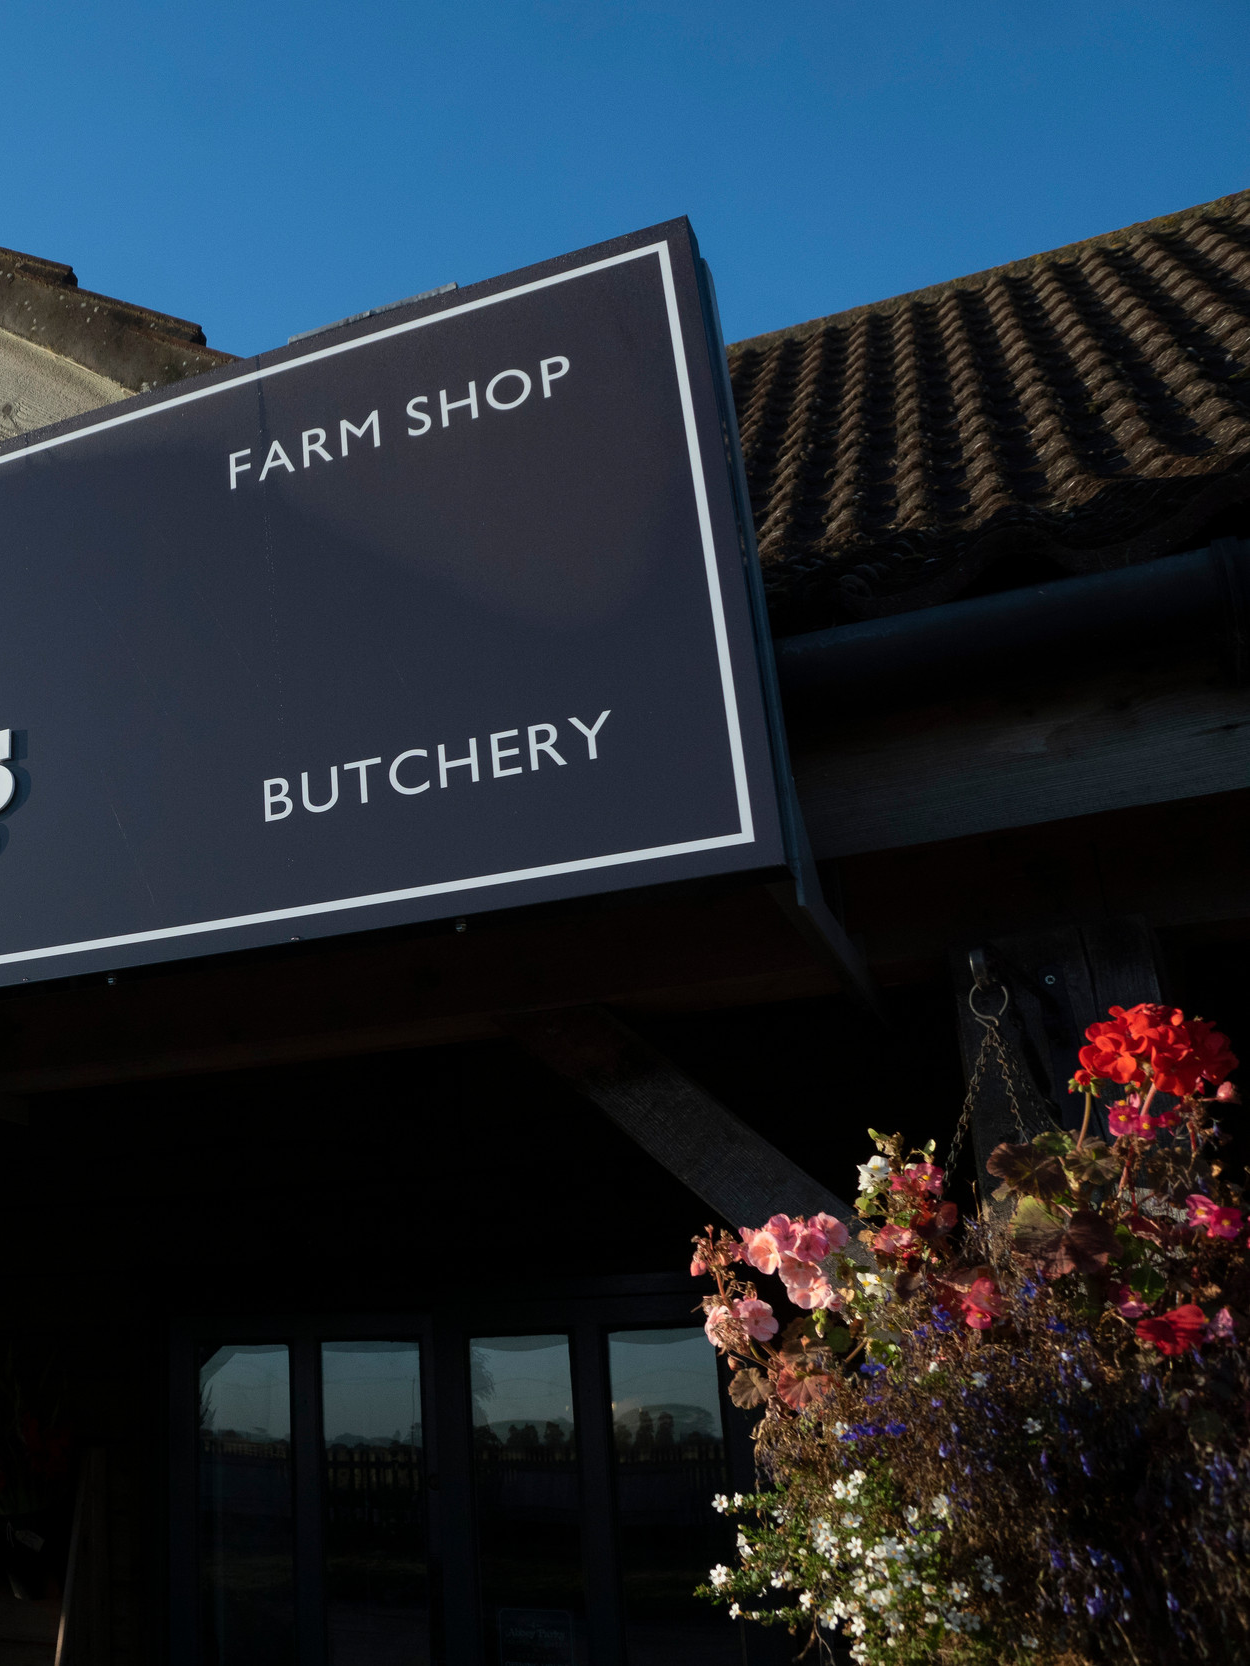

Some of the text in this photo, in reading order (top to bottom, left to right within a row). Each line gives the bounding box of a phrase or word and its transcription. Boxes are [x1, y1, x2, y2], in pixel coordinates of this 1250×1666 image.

[228, 355, 571, 490] FARM SHOP
[263, 709, 612, 823] BUTCHERY
